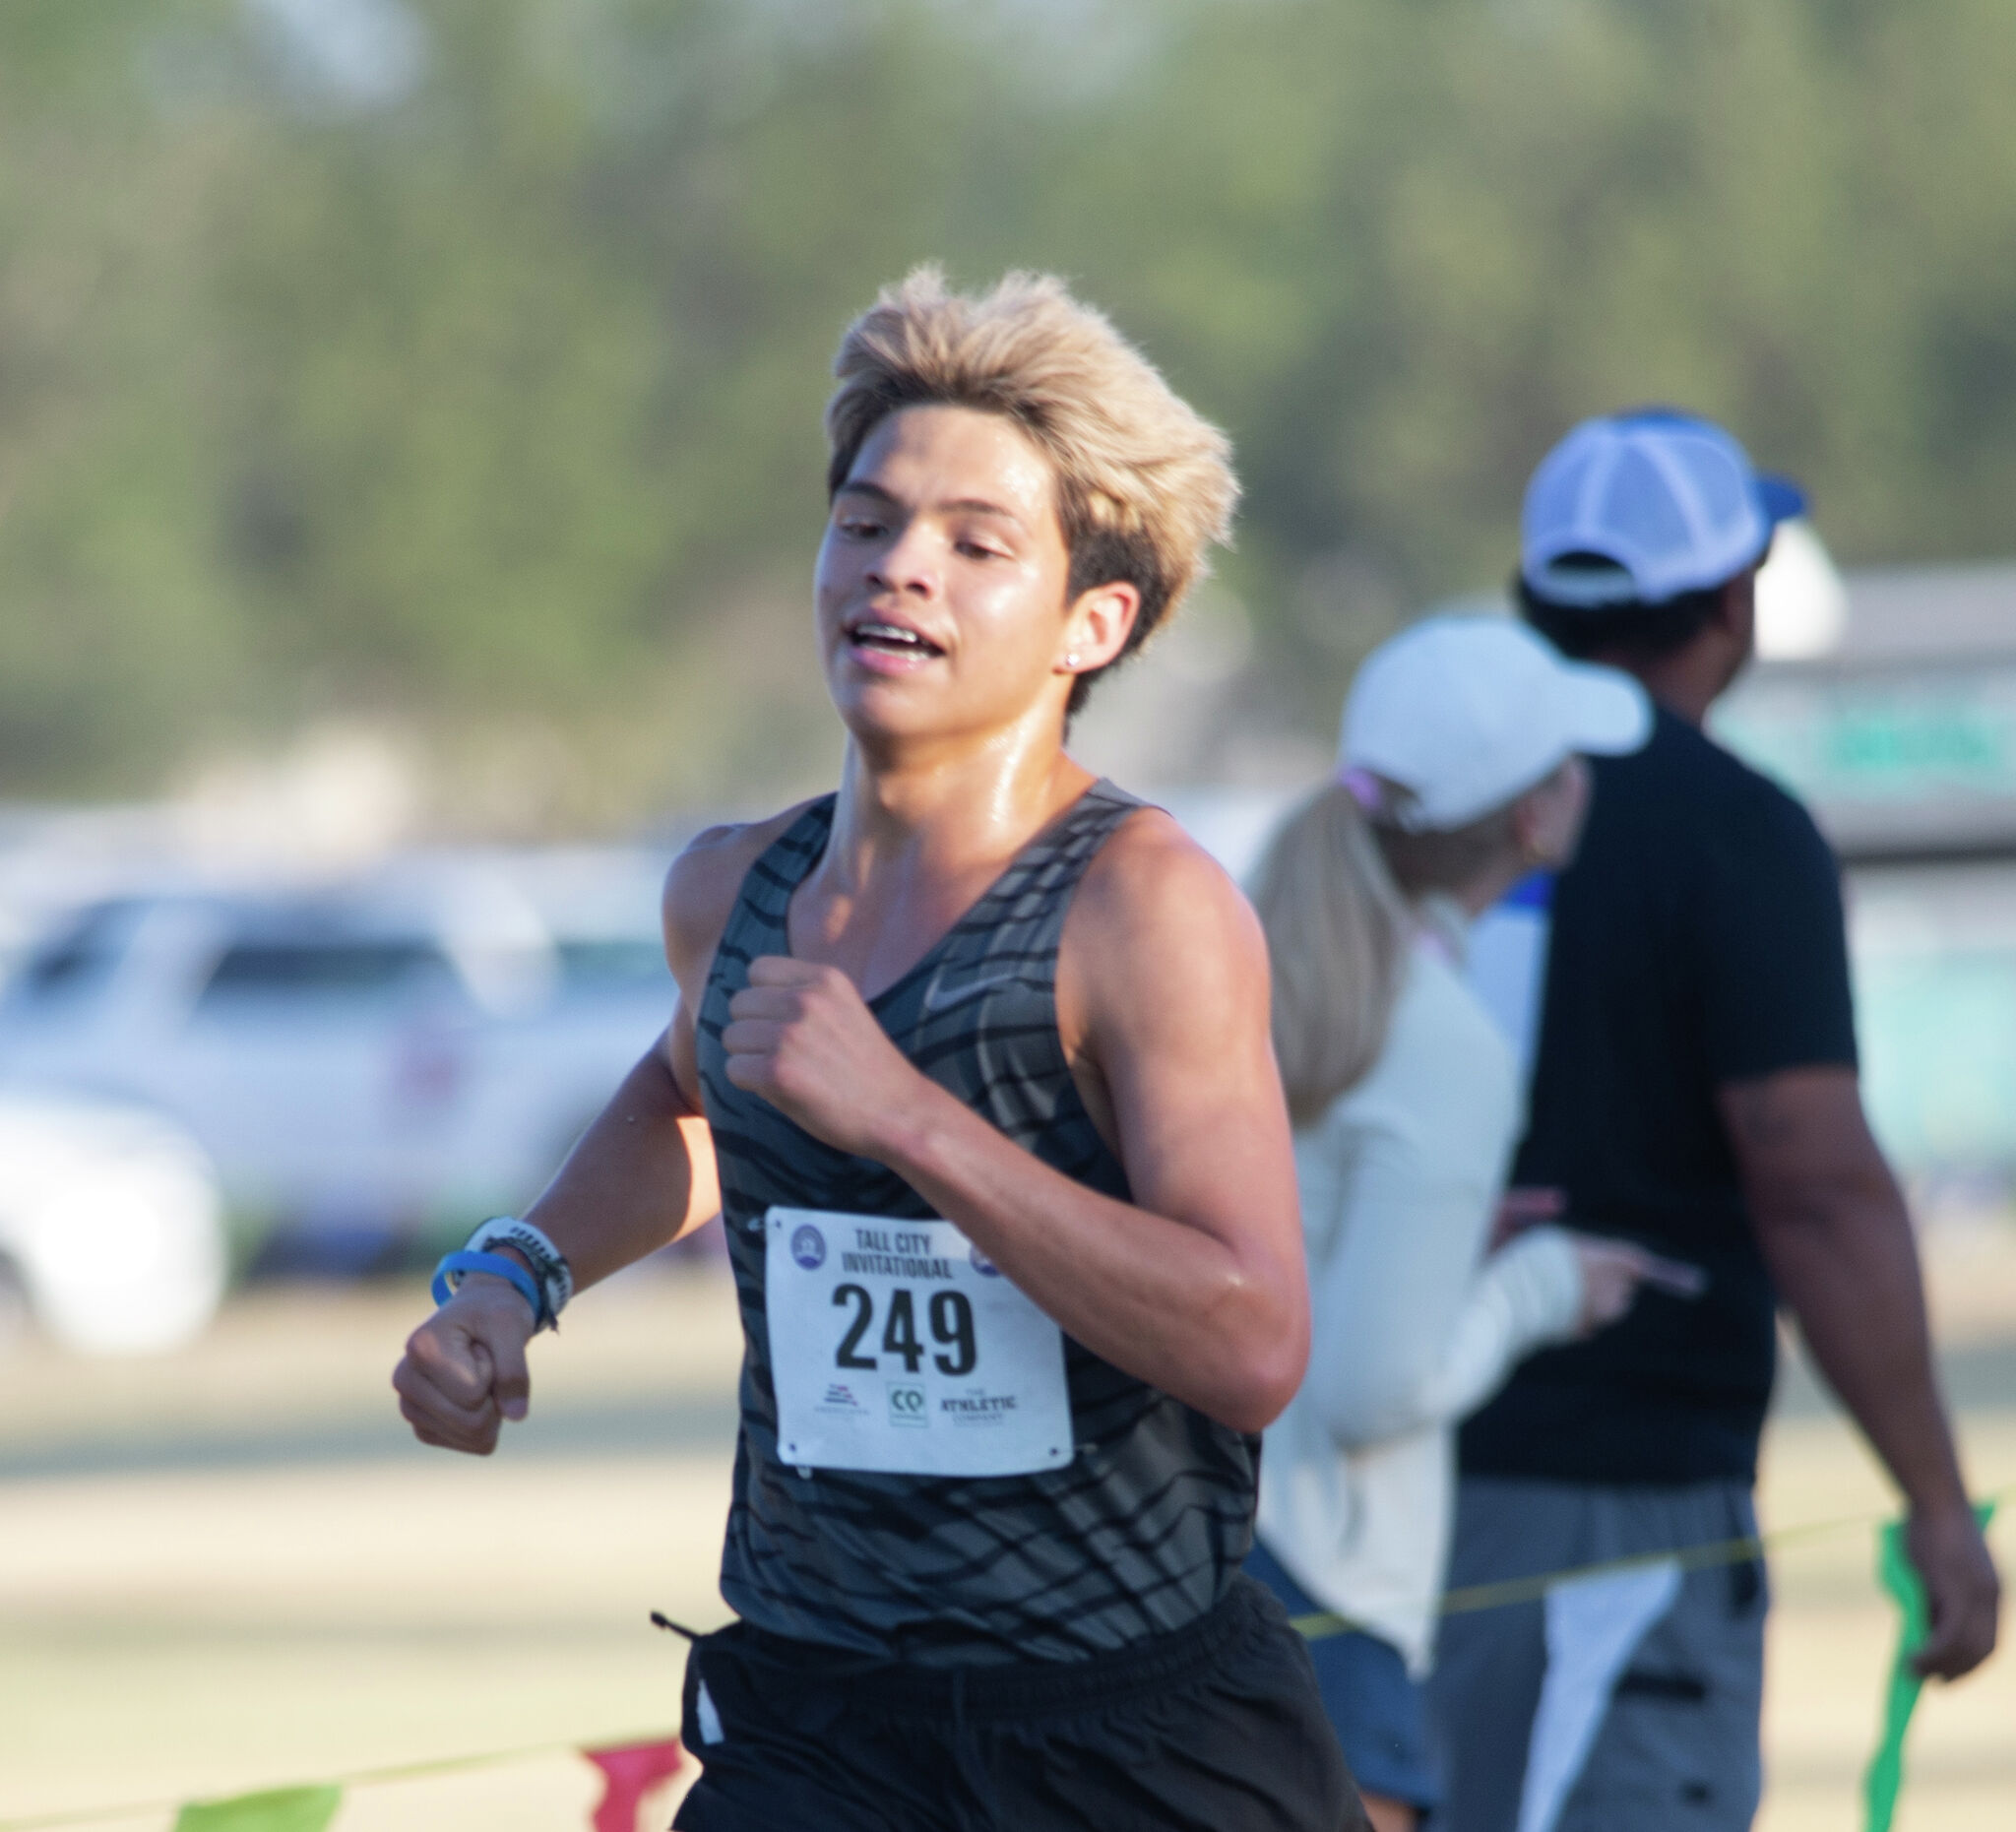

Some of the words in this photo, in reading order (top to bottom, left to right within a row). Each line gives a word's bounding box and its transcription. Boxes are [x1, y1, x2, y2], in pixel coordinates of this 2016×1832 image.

[855, 1229, 890, 1253] TALL
[896, 1232, 931, 1255] CITY
[842, 1252, 952, 1279] INVITATIONAL
[832, 1283, 976, 1377] 249
[941, 1396, 1016, 1413] ATHLETIC
